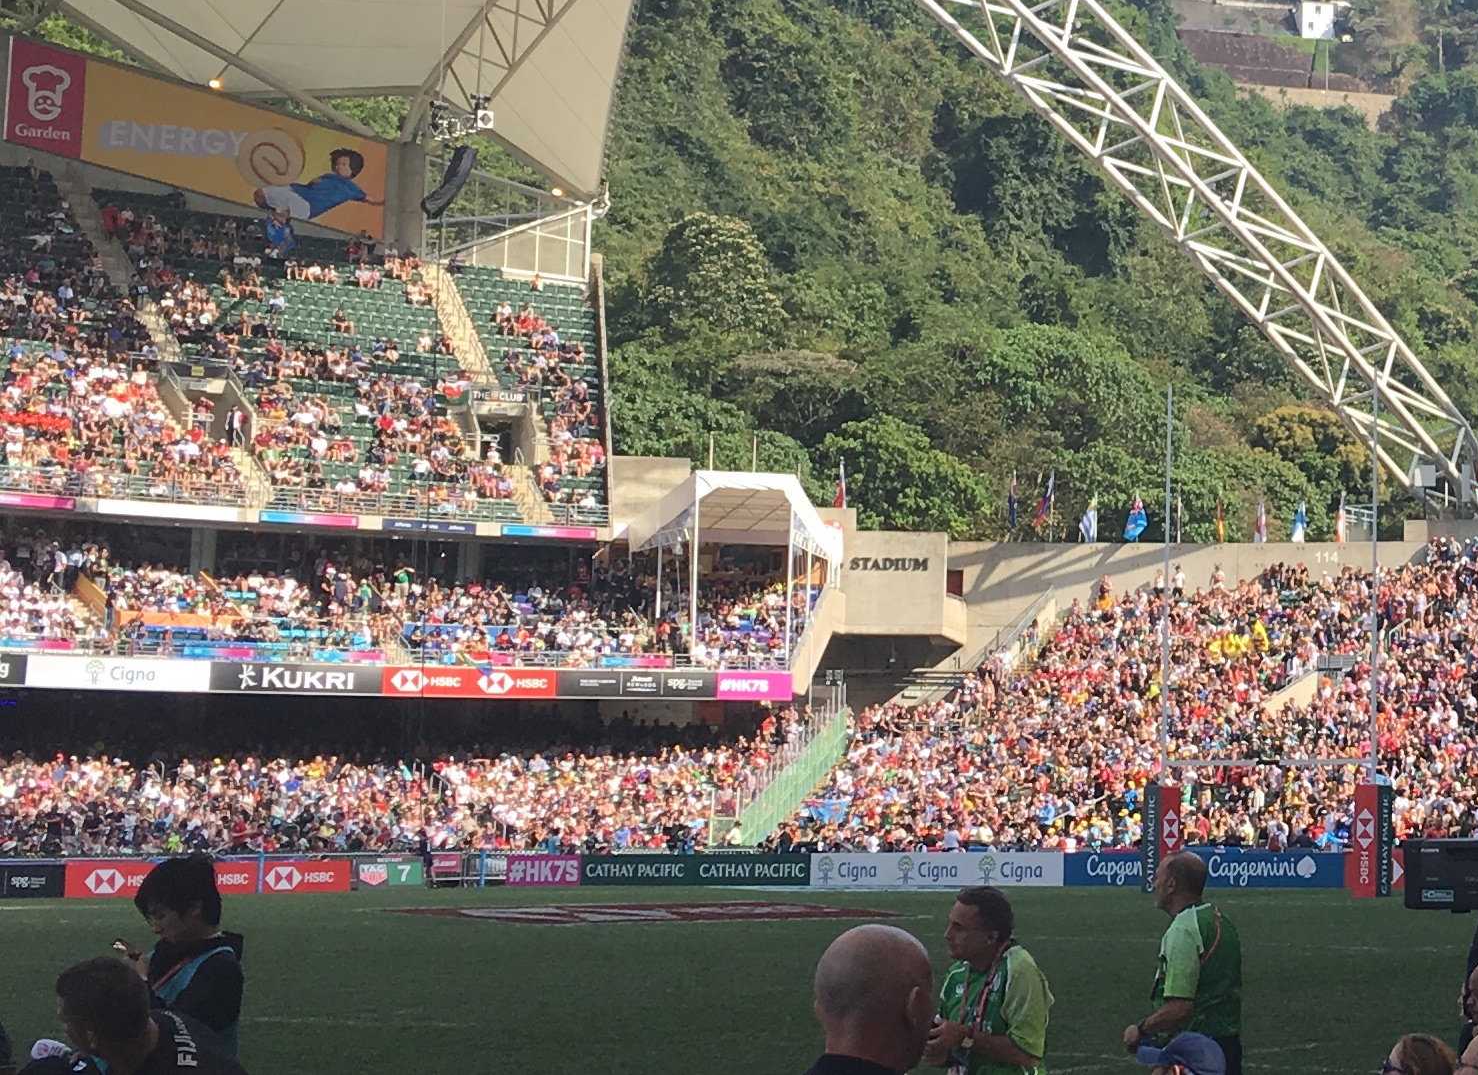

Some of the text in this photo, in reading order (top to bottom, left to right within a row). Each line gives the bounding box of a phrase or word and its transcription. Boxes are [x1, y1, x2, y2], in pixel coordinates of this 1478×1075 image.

[15, 123, 71, 142] Garden
[109, 120, 248, 158] ENERGY
[850, 556, 928, 573] STADIUM
[1315, 551, 1339, 564] 114
[110, 664, 156, 686] Cigna
[261, 666, 354, 691] KUKRI
[430, 676, 462, 687] HSBC
[516, 678, 549, 689] HSBC
[303, 871, 335, 883] HSBC
[397, 864, 412, 882] 7
[508, 858, 579, 883] #HK7S
[586, 862, 684, 879] CATHAY PACIFIC
[699, 862, 806, 879] CATHAY PACIFIC
[837, 861, 877, 883] Cigna
[918, 861, 958, 884] Cigna
[1001, 861, 1044, 885] Cigna
[1208, 853, 1296, 886] Capgemini
[1360, 851, 1369, 885] HSBC
[217, 873, 249, 885] HSBC
